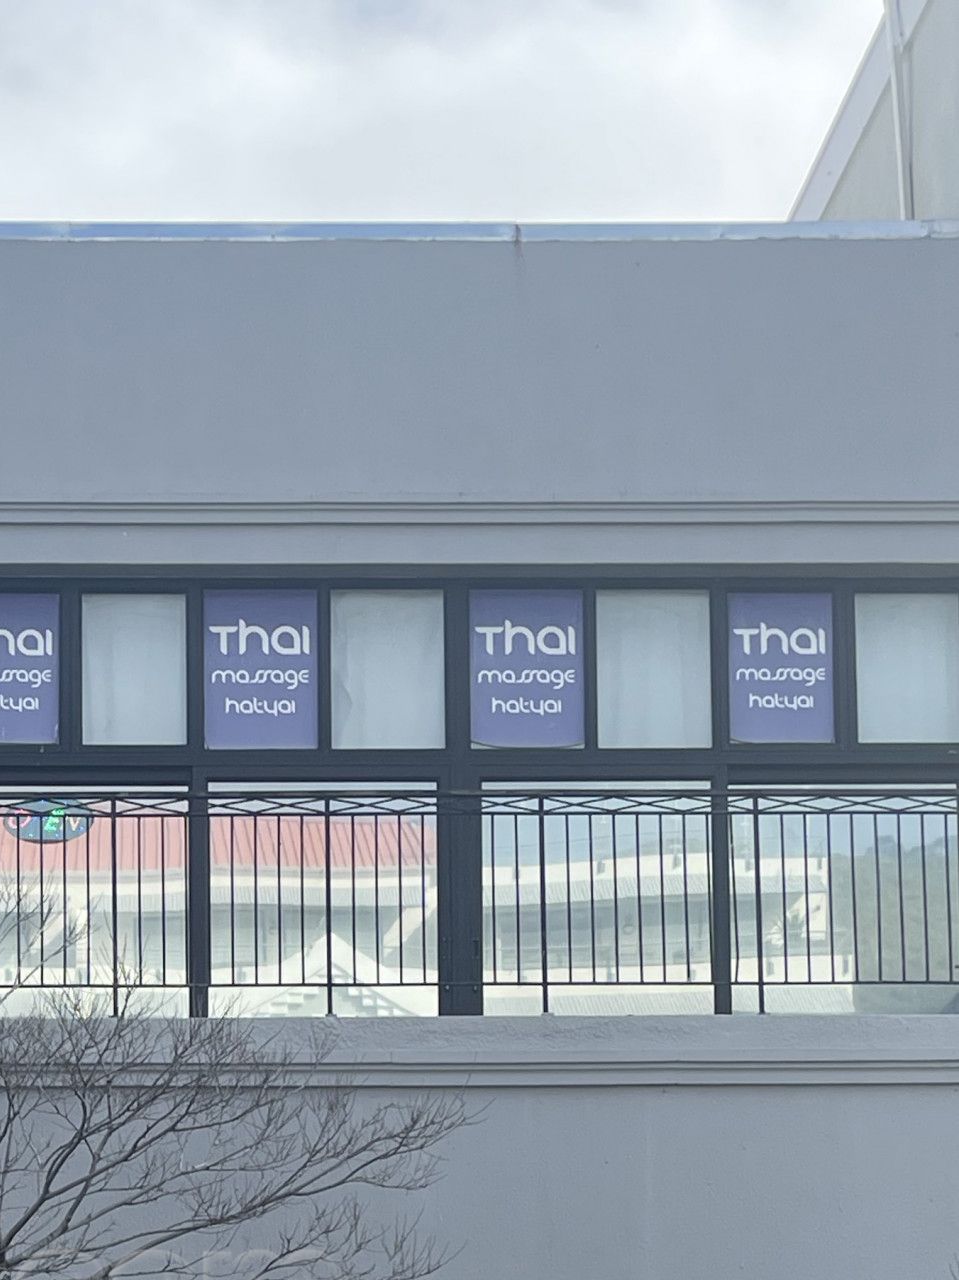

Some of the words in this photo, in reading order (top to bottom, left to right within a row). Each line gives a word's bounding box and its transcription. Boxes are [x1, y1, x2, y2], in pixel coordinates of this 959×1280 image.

[209, 619, 310, 655] Thai
[475, 620, 576, 655] Thai
[733, 622, 826, 655] Thai
[212, 670, 310, 689] massage
[478, 670, 576, 689] massage
[736, 668, 825, 686] massage
[225, 697, 295, 716] hatyai
[492, 697, 562, 715] hatyai
[749, 693, 814, 711] hatyai
